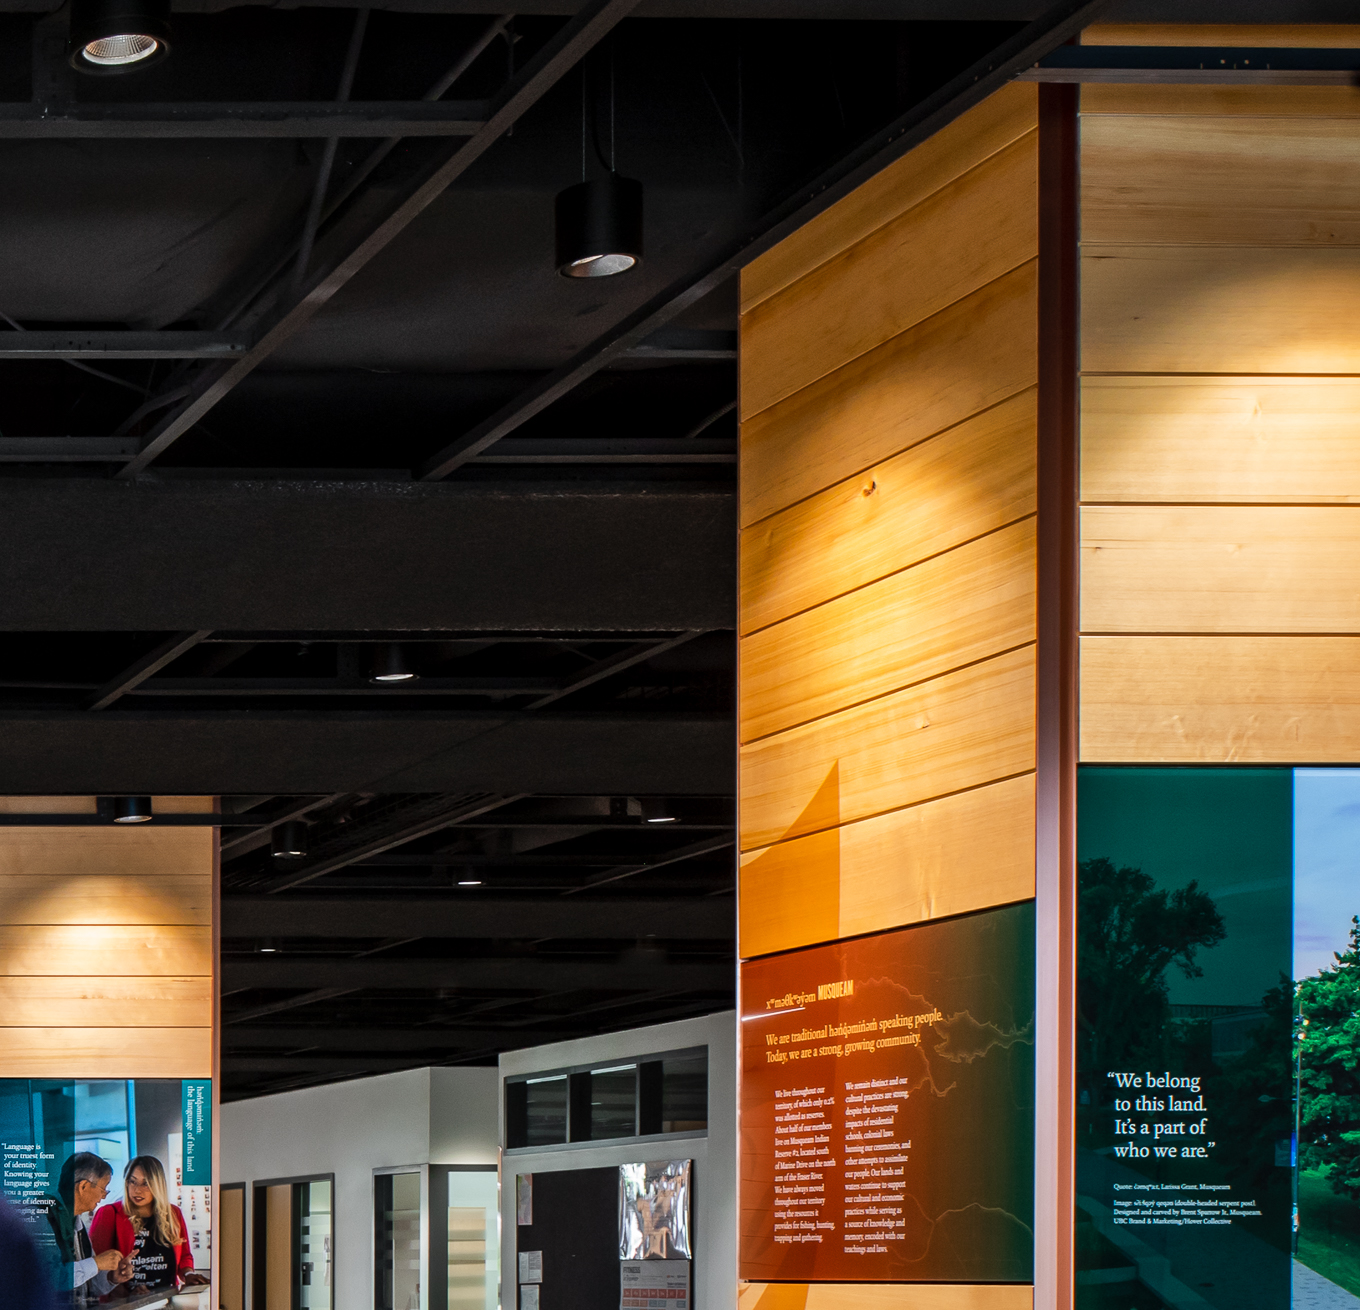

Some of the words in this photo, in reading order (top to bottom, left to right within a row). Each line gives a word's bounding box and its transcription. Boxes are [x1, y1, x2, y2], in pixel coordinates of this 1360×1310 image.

[818, 980, 853, 1001] MUSQUEAM
[766, 1034, 778, 1045] We
[779, 1035, 790, 1044] are
[791, 1025, 827, 1043] traditional
[879, 1015, 913, 1033] speaking
[915, 1008, 943, 1028] people.
[766, 1050, 788, 1064] Today,
[789, 1051, 800, 1060] we
[801, 1049, 812, 1059] are
[813, 1048, 818, 1057] a
[819, 1044, 843, 1057] strong,
[845, 1039, 875, 1056] growing
[876, 1032, 921, 1046] community.
[1147, 1072, 1201, 1092] belong
[187, 1086, 195, 1098] the
[1115, 1099, 1131, 1111] to
[1136, 1096, 1164, 1111] this
[1170, 1095, 1207, 1111] land.
[185, 1099, 195, 1131] language
[187, 1132, 195, 1140] of
[1141, 1124, 1149, 1134] a
[1155, 1123, 1185, 1139] part
[1190, 1118, 1208, 1134] of
[187, 1141, 195, 1154] this
[1114, 1142, 1149, 1158] who
[1155, 1147, 1177, 1158] we
[4, 1171, 33, 1179] Knowing
[4, 1180, 32, 1188] language
[34, 1180, 50, 1188] gives
